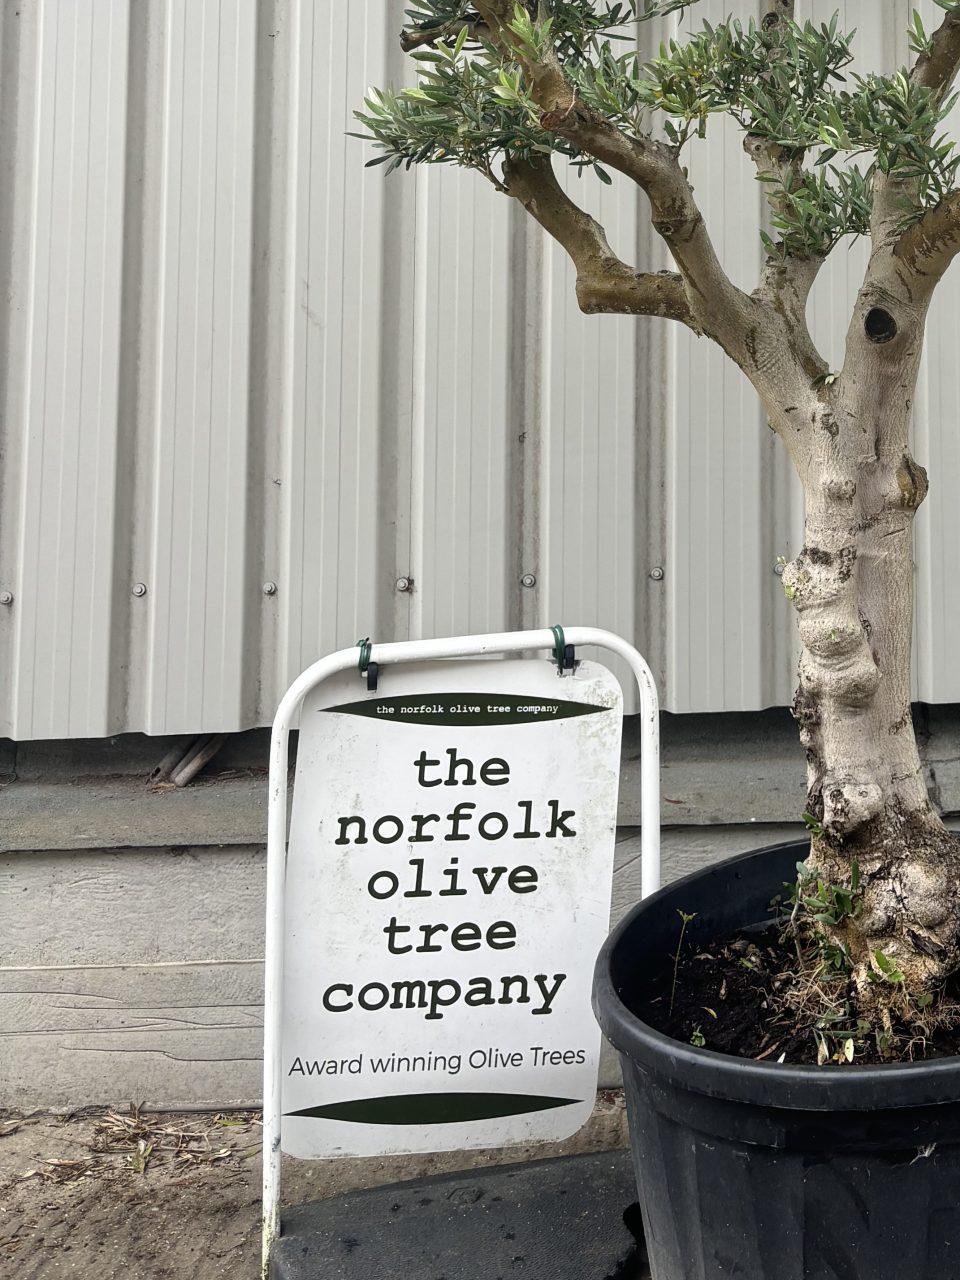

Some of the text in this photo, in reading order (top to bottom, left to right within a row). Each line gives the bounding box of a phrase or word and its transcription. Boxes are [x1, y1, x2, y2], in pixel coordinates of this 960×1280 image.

[376, 704, 559, 715] the norfolk olive tree company
[414, 748, 510, 787] the
[335, 800, 577, 845] norfolk
[368, 858, 539, 899] olive
[384, 917, 517, 954] tree
[323, 973, 566, 1019] company
[288, 1047, 586, 1076] Award winning Olive Trees
